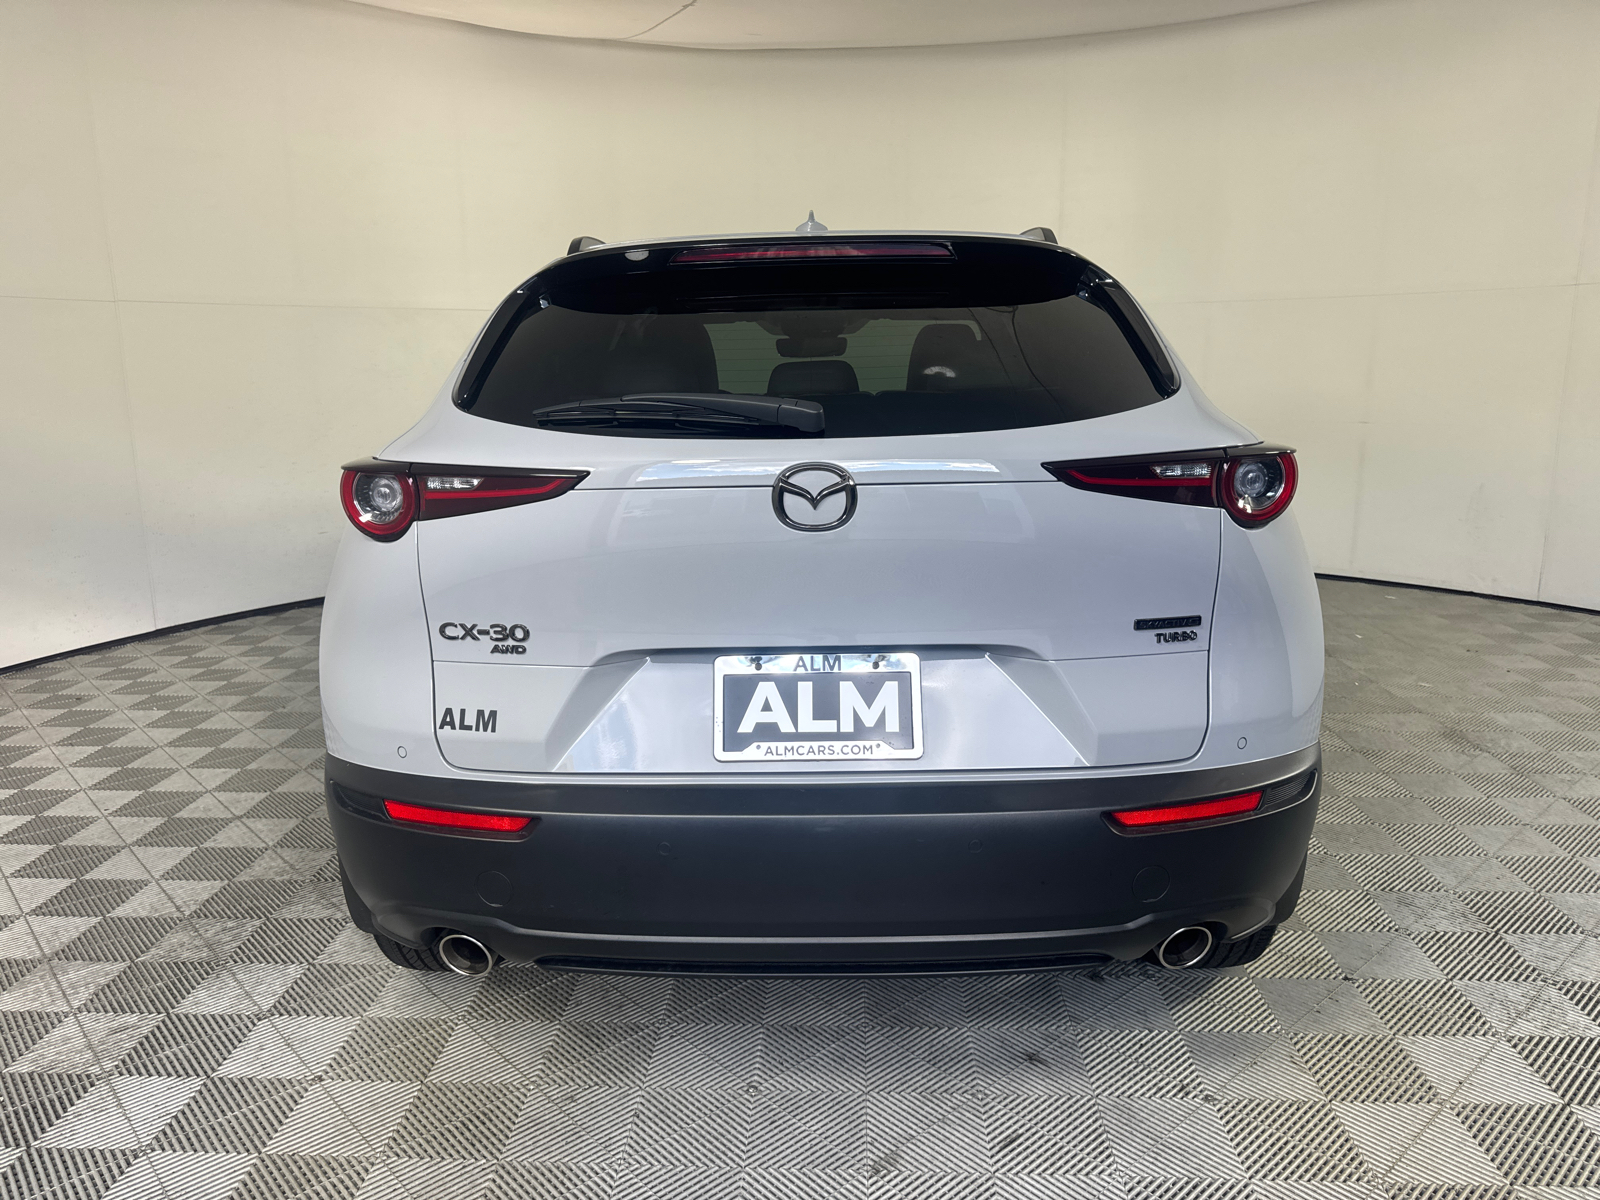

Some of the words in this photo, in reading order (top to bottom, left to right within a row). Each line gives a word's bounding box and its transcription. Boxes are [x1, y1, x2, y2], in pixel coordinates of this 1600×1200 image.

[438, 622, 530, 642] CX-30
[1154, 630, 1198, 644] TURBO
[490, 644, 527, 655] AWD
[793, 655, 842, 672] ALM
[737, 681, 900, 733] ALM
[438, 707, 498, 733] ALM
[764, 744, 874, 756] ALMCARS.COM
